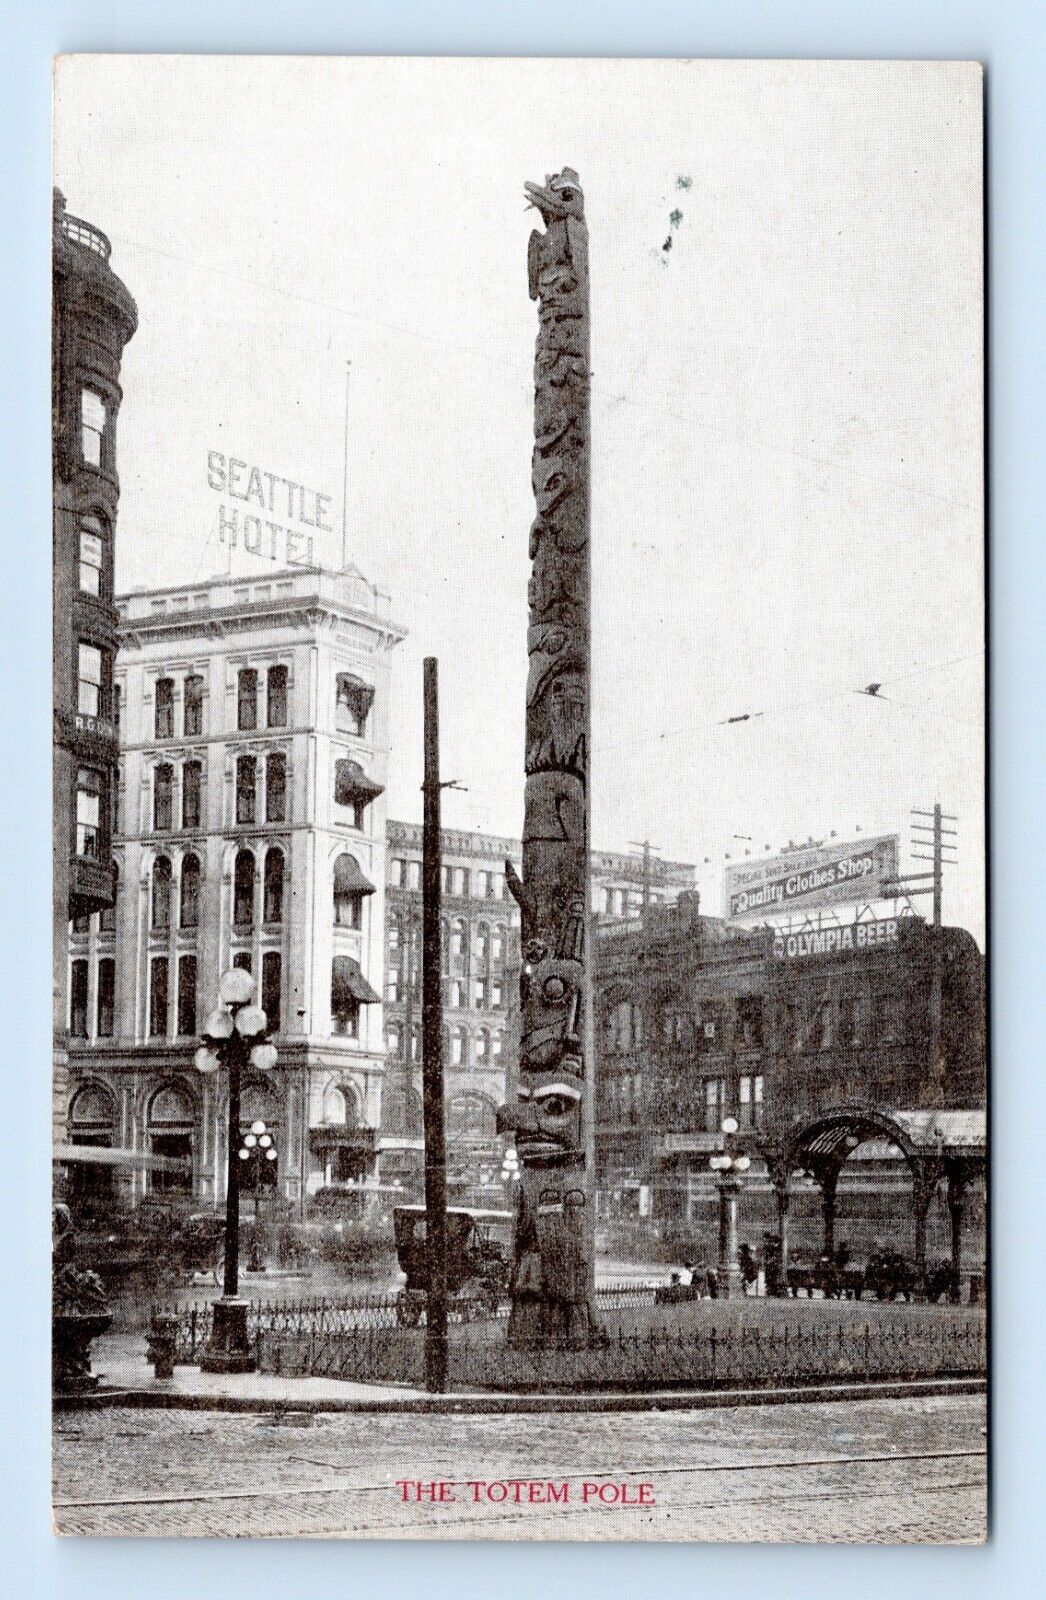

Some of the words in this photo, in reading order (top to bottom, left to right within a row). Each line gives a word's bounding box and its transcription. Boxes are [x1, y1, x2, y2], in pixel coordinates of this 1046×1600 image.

[207, 450, 333, 533] SEATTLE
[219, 504, 321, 569] HOTEL
[736, 884, 783, 913] Quality
[785, 869, 835, 895] Clothes
[837, 857, 872, 879] Shop
[787, 929, 854, 957] OLYMPIA
[856, 920, 898, 946] BEER
